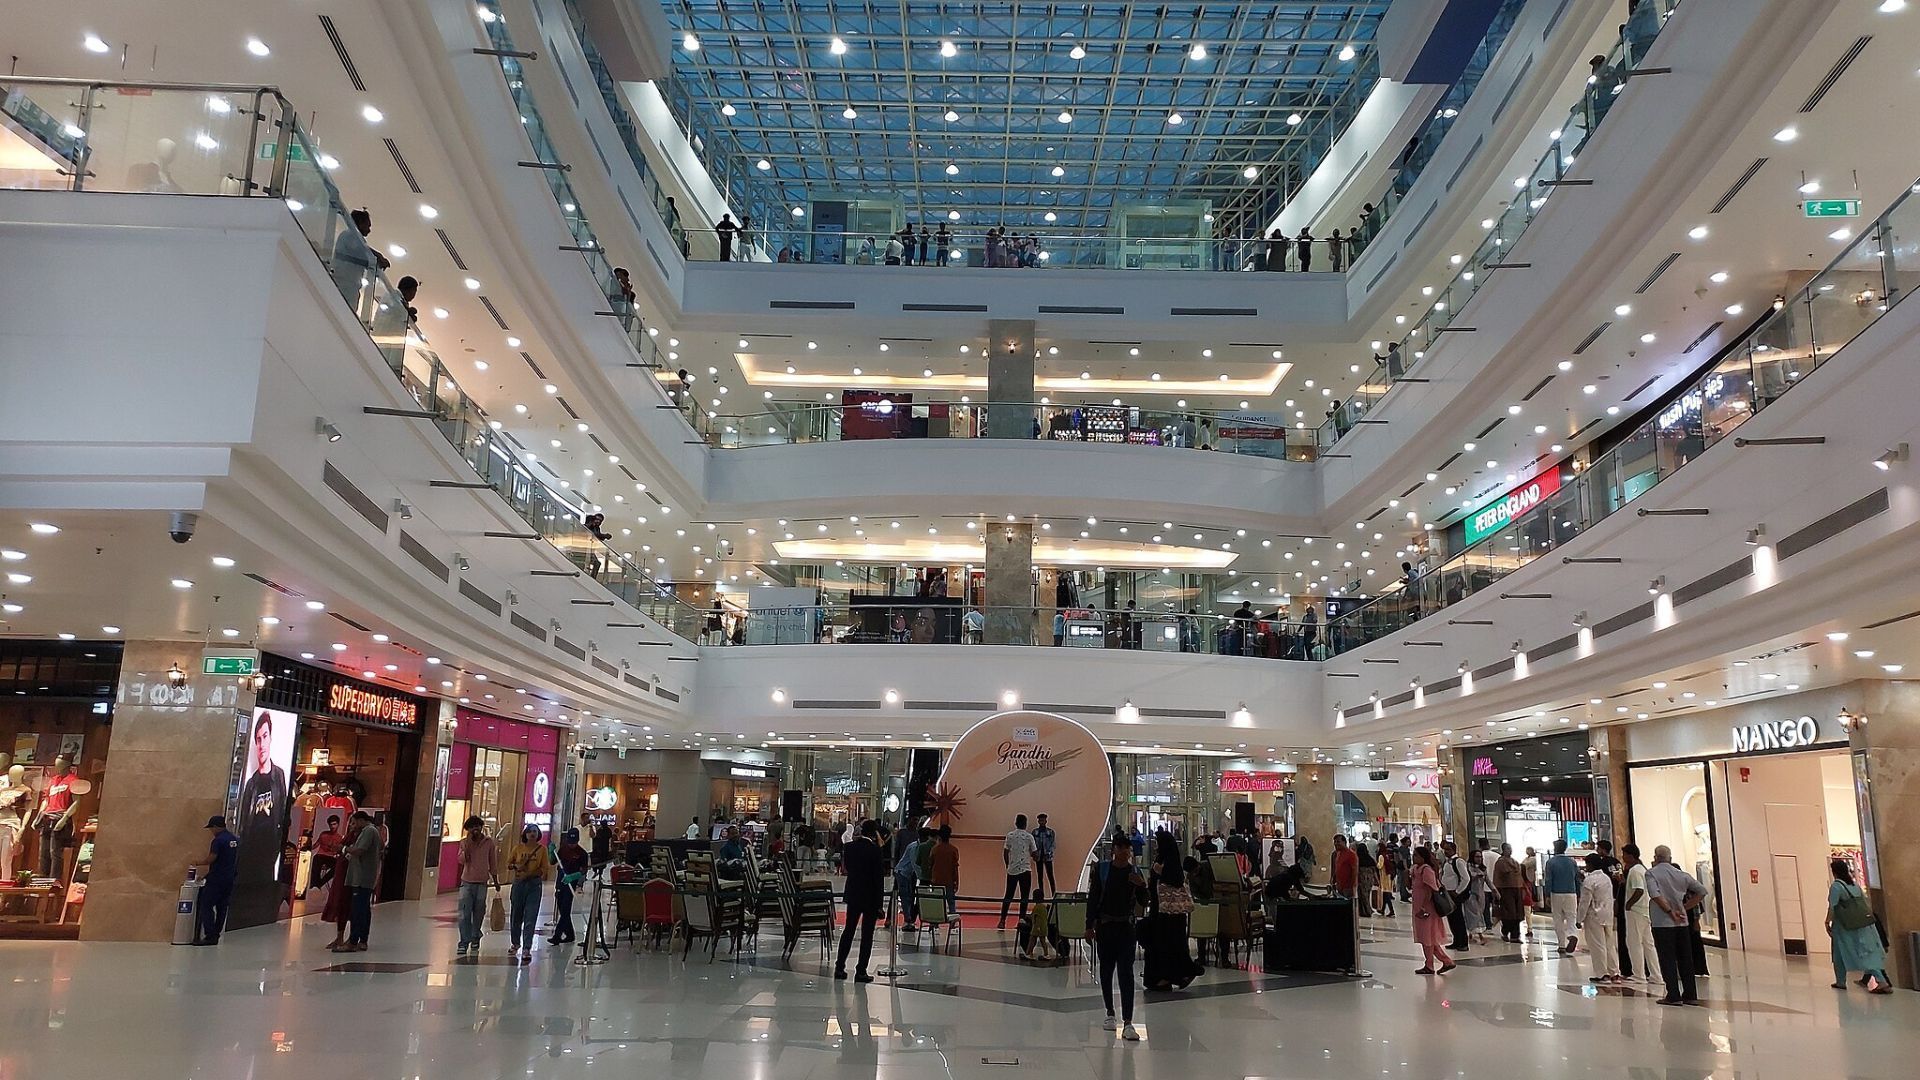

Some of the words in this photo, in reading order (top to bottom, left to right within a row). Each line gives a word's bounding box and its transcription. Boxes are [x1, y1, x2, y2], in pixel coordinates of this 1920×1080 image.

[1475, 508, 1498, 533] PETER
[1497, 483, 1540, 522] ENGLAND
[330, 684, 384, 718] SUPERDRY
[1732, 716, 1818, 752] MANGO
[997, 741, 1053, 764] Gandhi
[1007, 759, 1057, 772] JAYANTI
[1224, 778, 1250, 791] JOSCO
